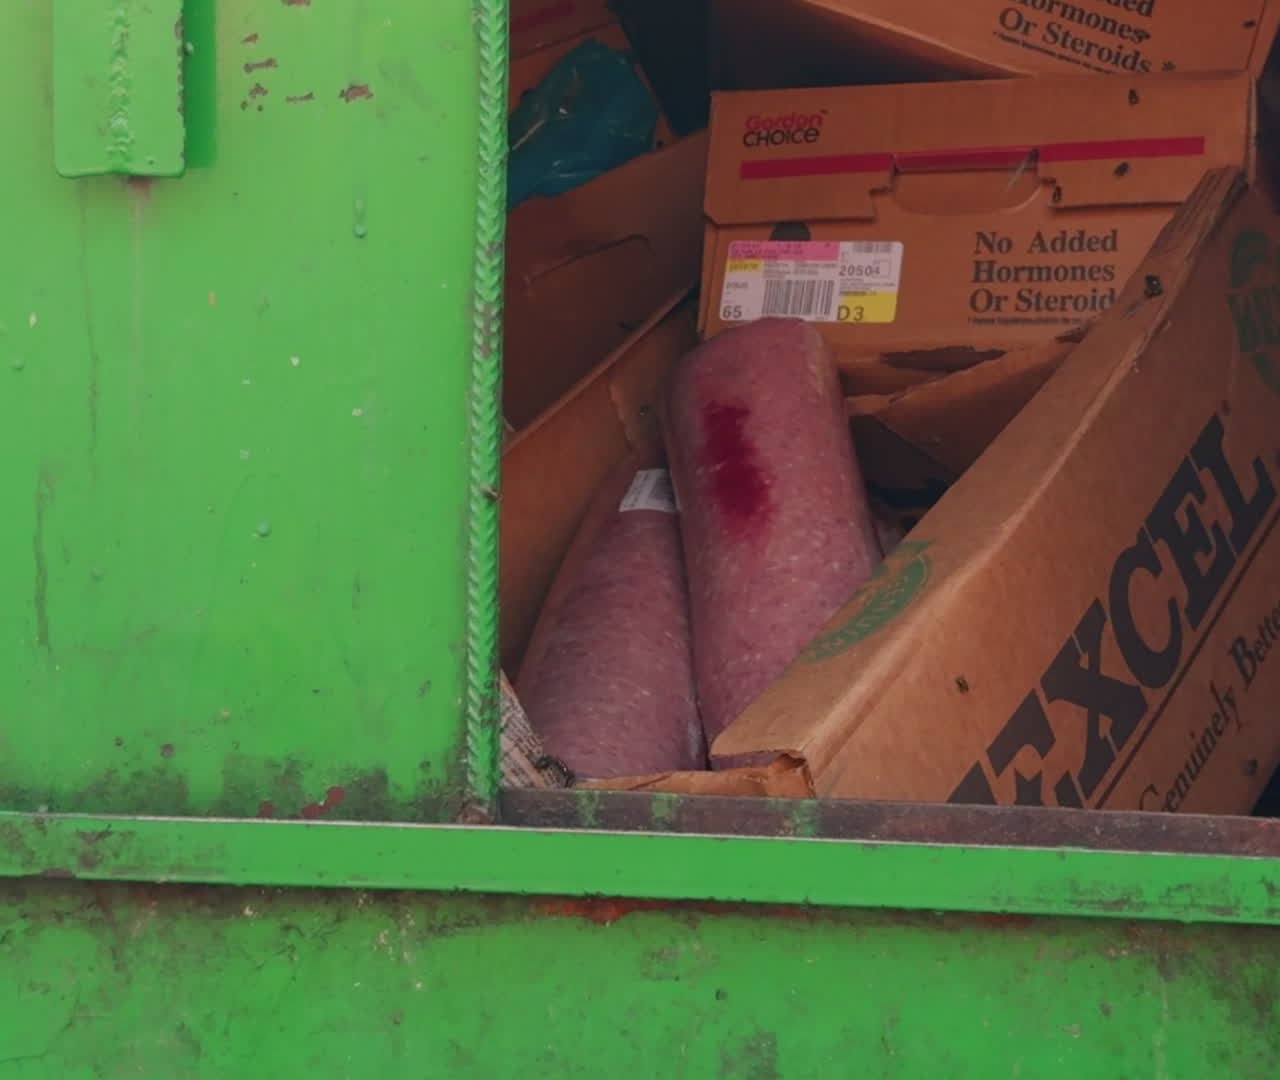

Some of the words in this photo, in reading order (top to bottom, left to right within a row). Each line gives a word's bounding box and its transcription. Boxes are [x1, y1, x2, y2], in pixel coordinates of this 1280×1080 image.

[998, 7, 1037, 36] Or
[1042, 21, 1153, 72] Steroids
[745, 111, 824, 131] Gordon
[974, 232, 1013, 254] No
[1027, 228, 1119, 254] Added
[971, 259, 1116, 283] Hormones
[722, 305, 743, 318] 65
[969, 287, 1009, 312] Or
